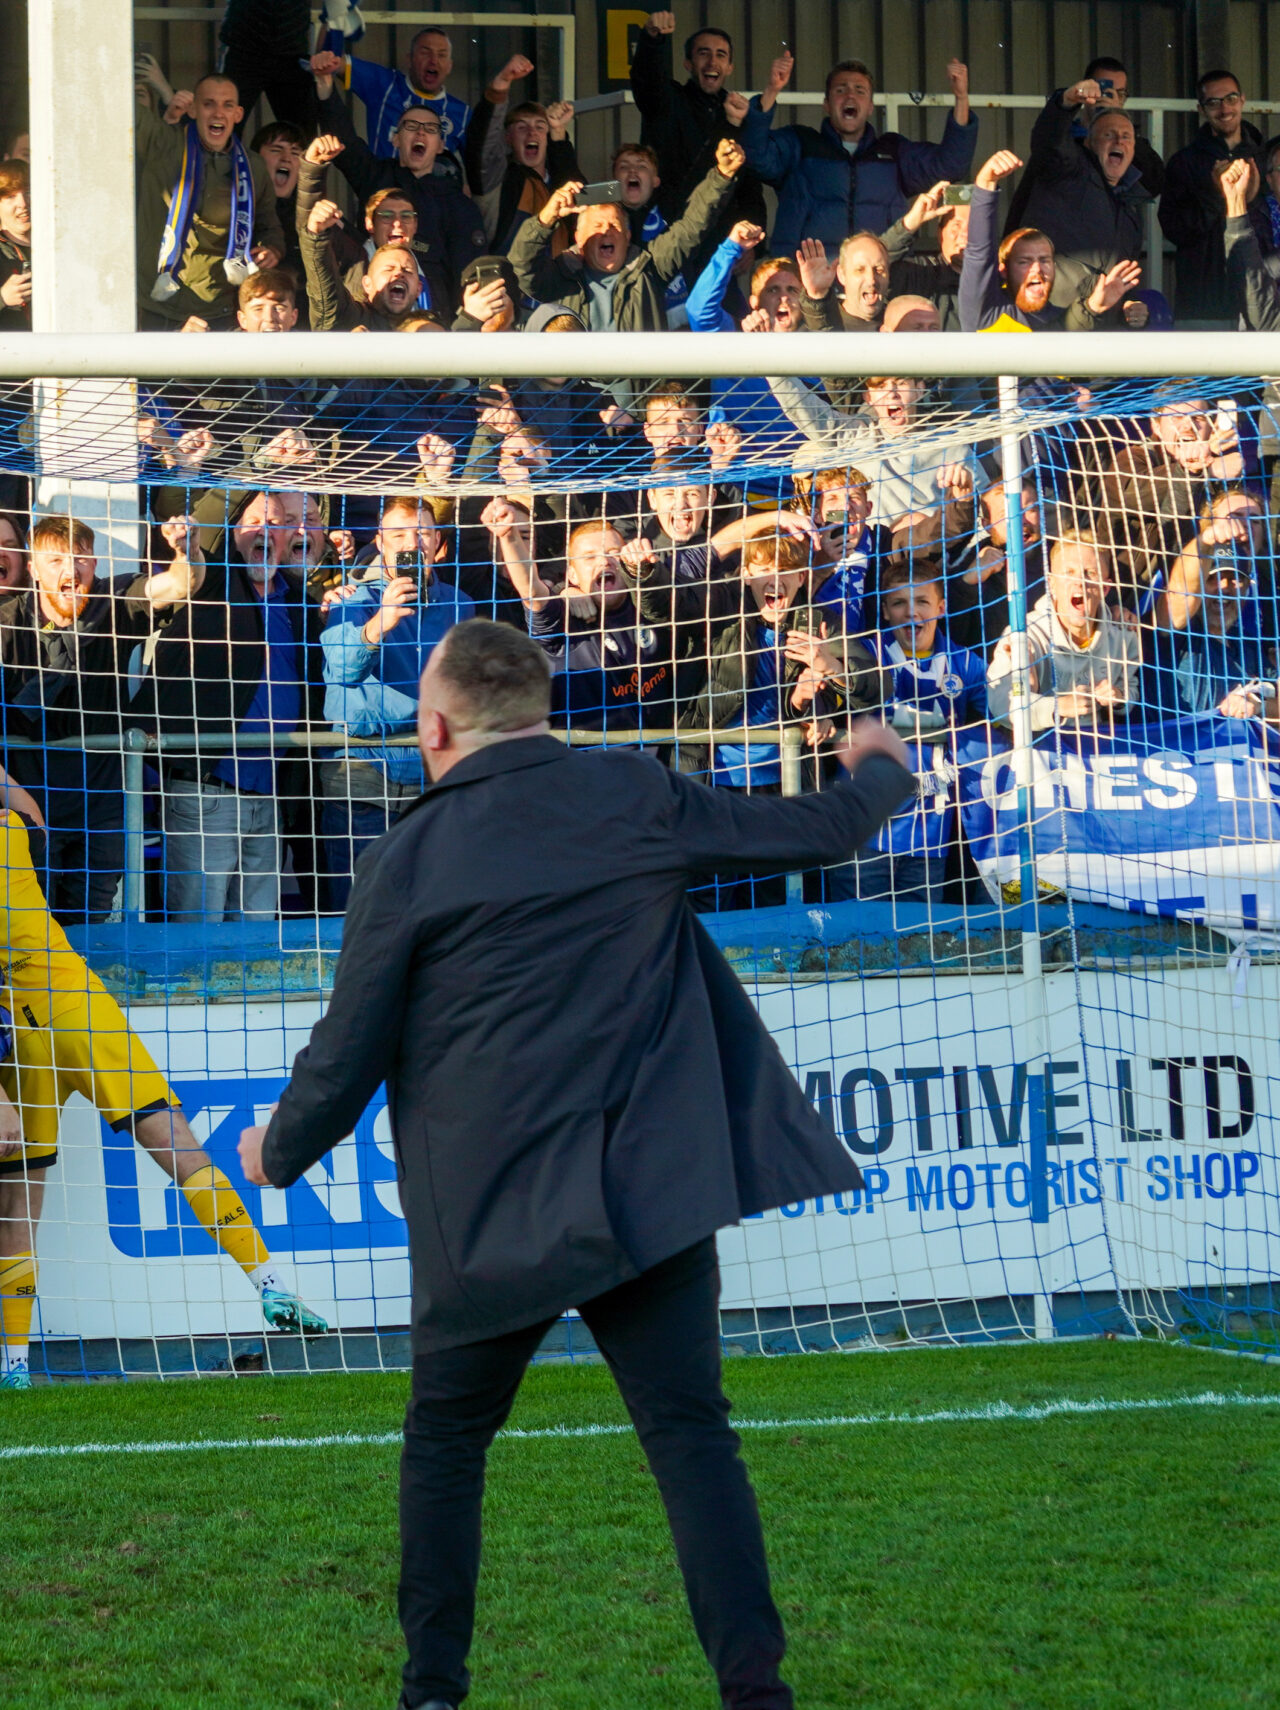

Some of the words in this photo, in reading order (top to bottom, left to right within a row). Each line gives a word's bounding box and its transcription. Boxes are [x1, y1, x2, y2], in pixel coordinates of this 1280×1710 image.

[1115, 1054, 1256, 1143] LTD
[906, 1157, 1131, 1212] MOTORIST
[1147, 1151, 1259, 1202] SHOP
